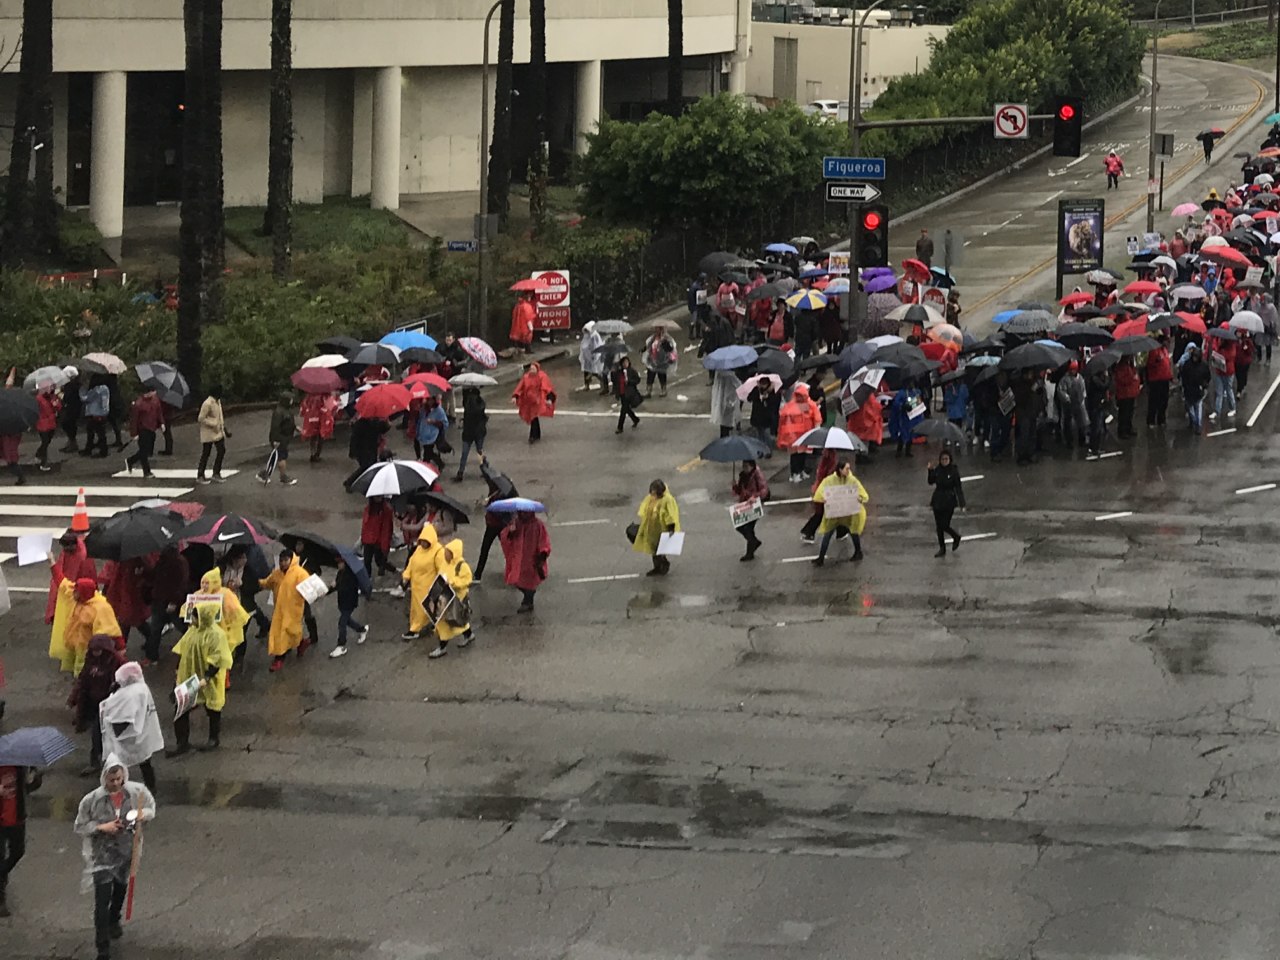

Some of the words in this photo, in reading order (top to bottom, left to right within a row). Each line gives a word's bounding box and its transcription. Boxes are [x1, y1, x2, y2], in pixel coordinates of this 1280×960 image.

[828, 160, 881, 175] Figueroa
[832, 188, 847, 196] ONE
[849, 188, 865, 196] WAY
[550, 277, 564, 286] NOT
[540, 293, 562, 301] ENTER
[541, 319, 562, 327] WAY
